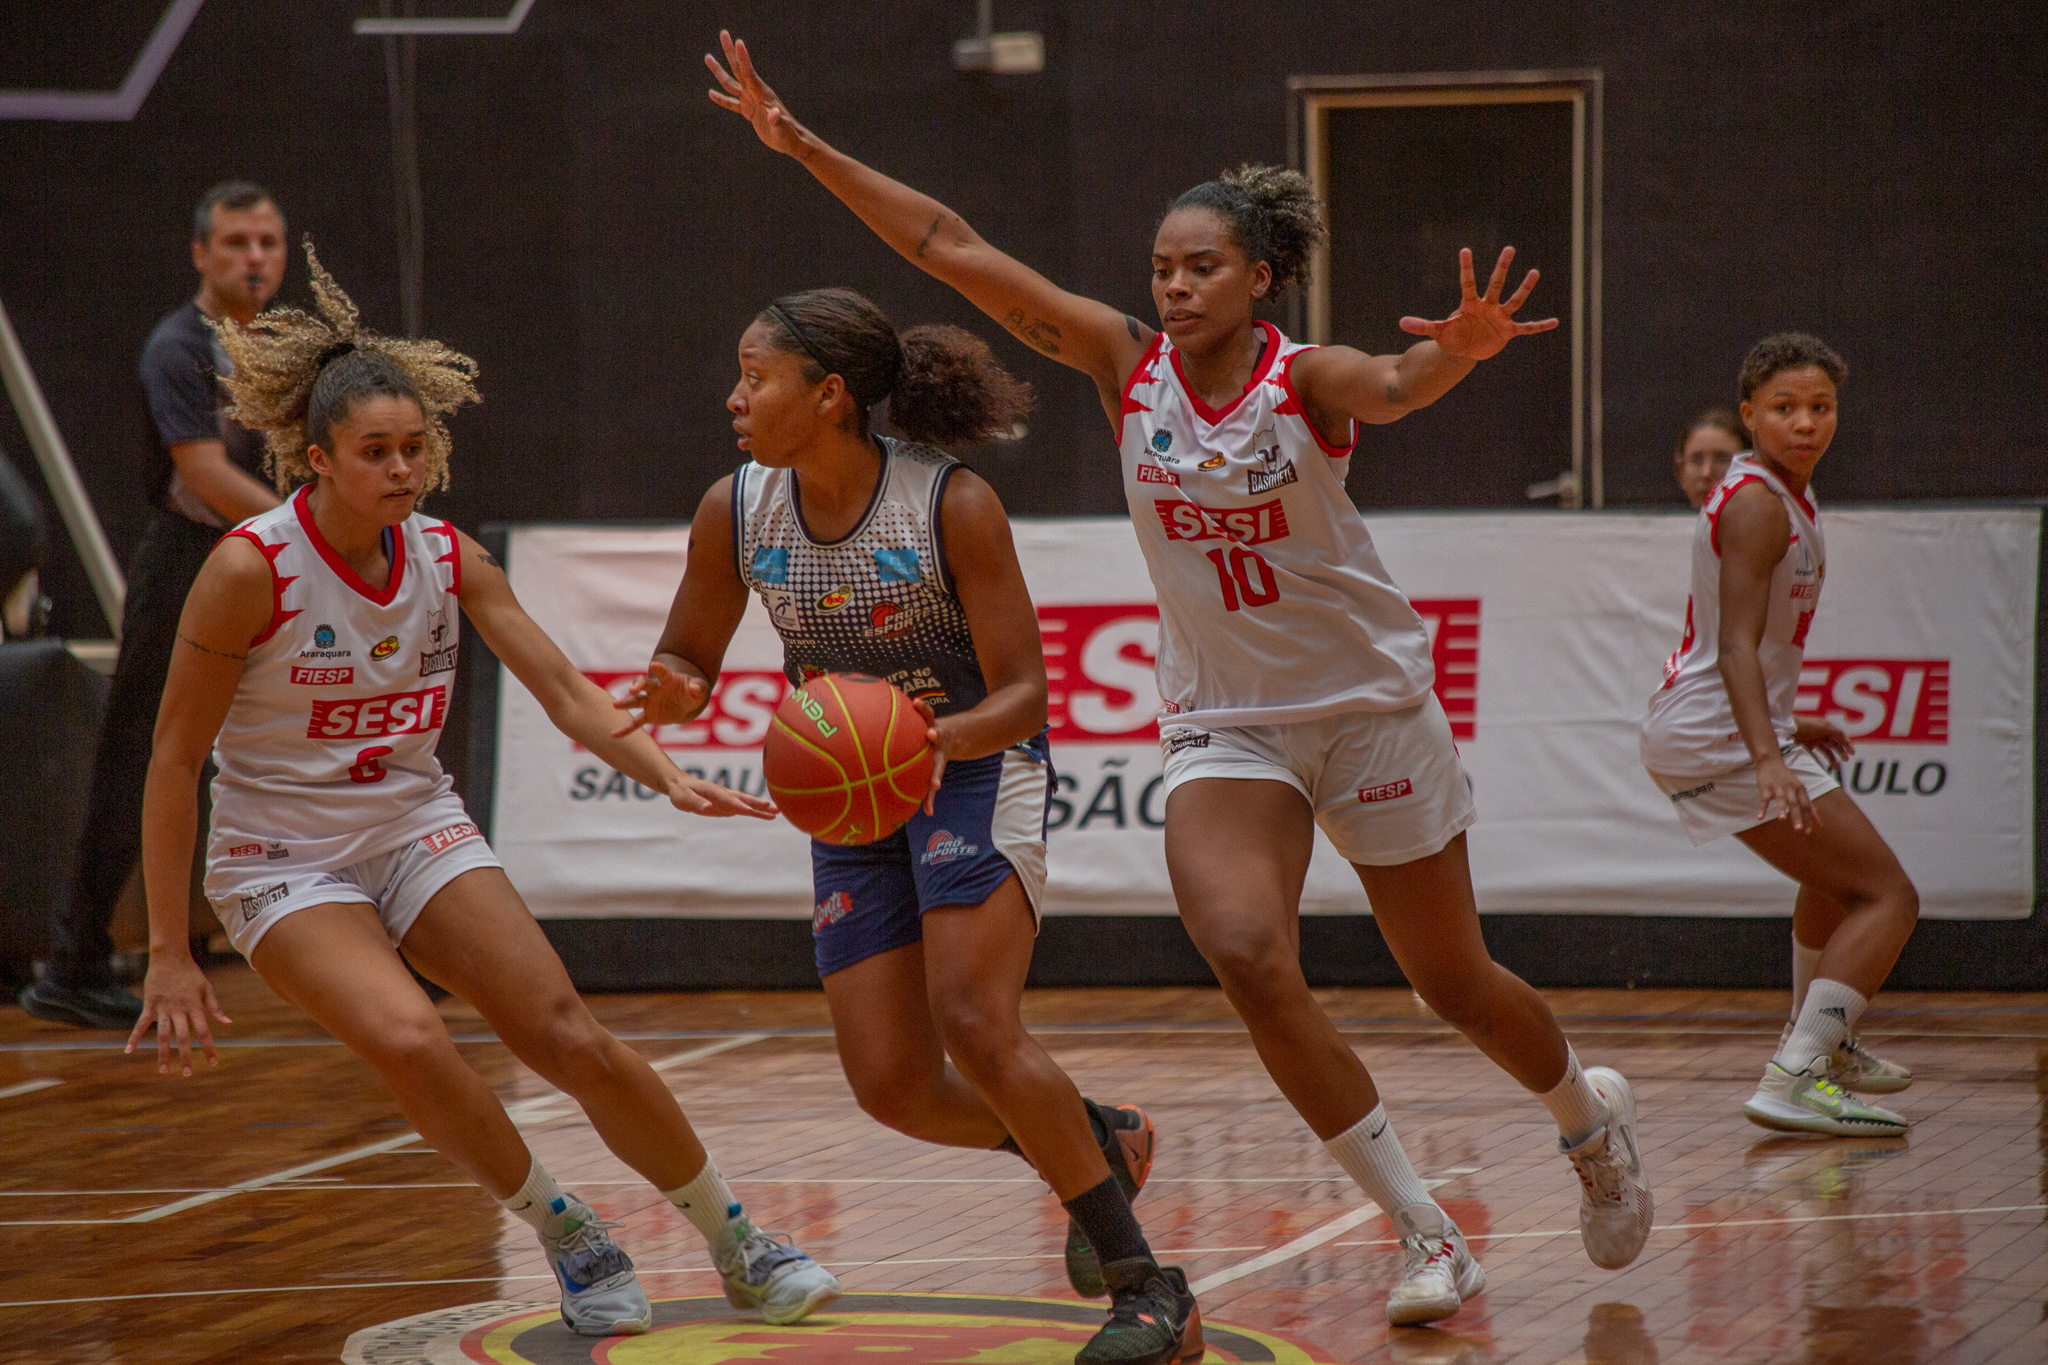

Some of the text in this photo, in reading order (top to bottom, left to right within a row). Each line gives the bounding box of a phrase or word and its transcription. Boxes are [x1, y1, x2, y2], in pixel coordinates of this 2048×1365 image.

[1251, 465, 1295, 493] BASQUETE
[1206, 547, 1280, 611] 10
[300, 650, 352, 660] Araraquara
[295, 669, 350, 684] FIESP
[903, 676, 942, 696] ABA
[321, 693, 435, 736] SESI
[1363, 782, 1408, 801] FIESP
[233, 845, 259, 857] SESI
[921, 845, 977, 862] ESPORTE
[936, 840, 962, 850] PRO
